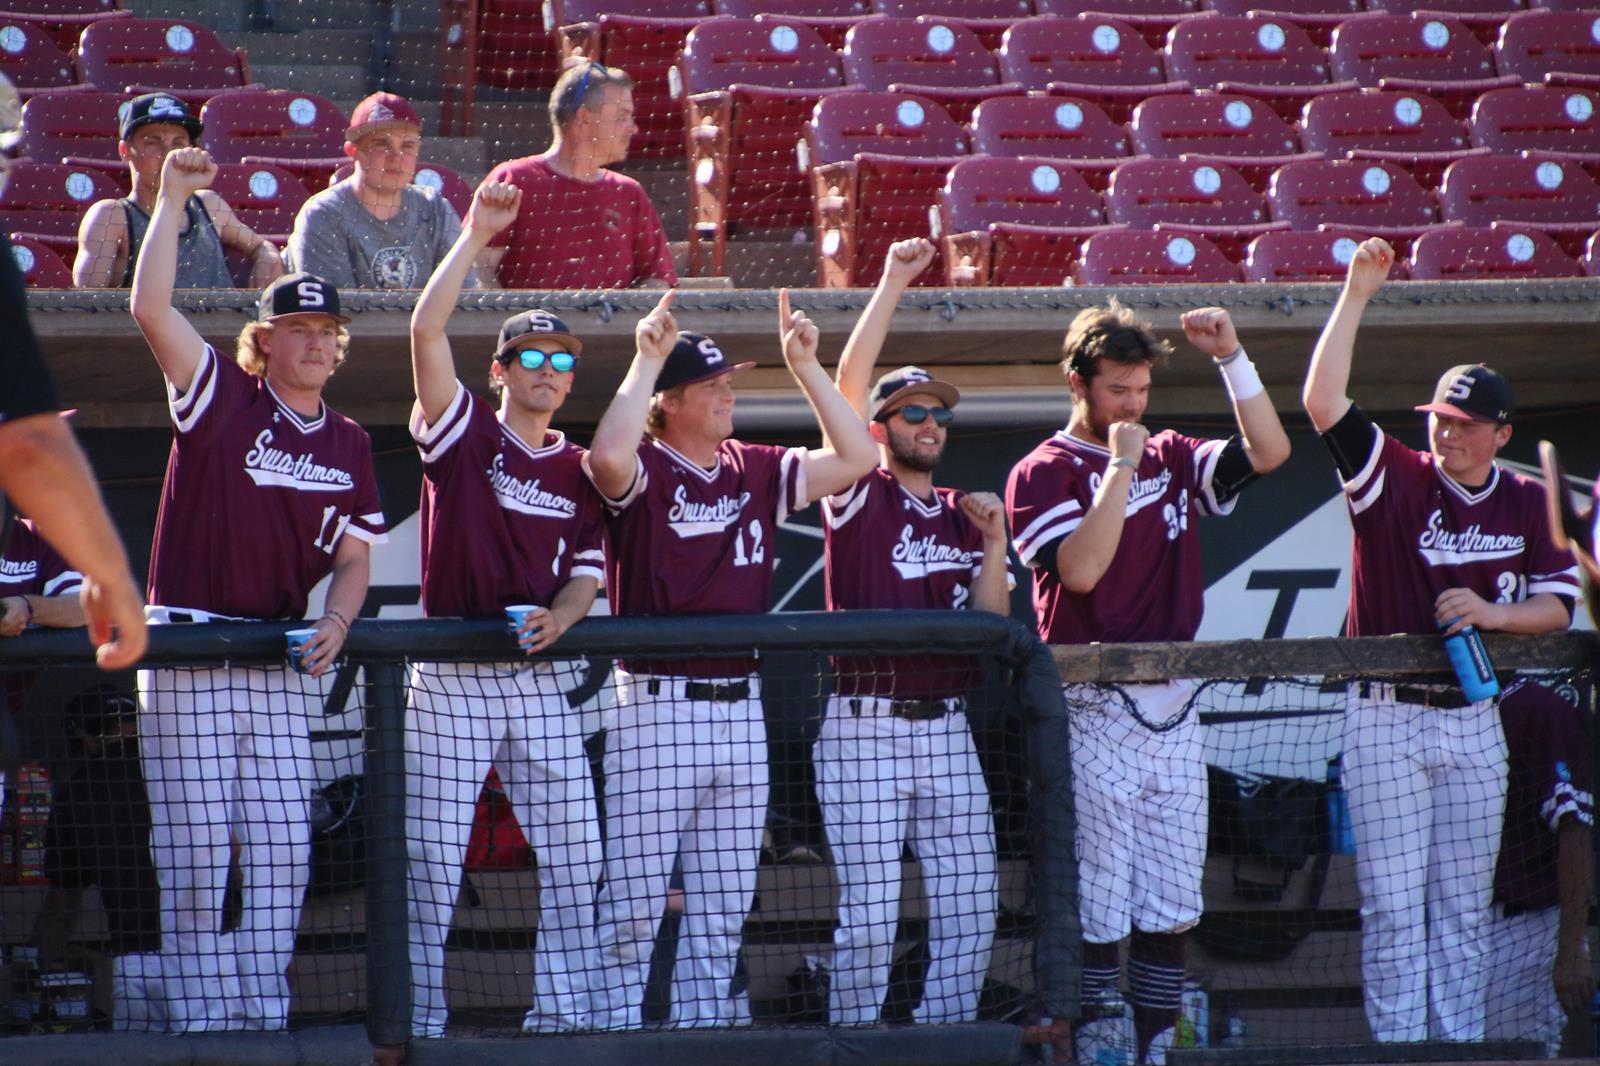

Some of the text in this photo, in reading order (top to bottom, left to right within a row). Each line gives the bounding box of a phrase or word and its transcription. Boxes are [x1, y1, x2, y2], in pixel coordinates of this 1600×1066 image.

[297, 282, 324, 306] S
[529, 312, 554, 331] S
[697, 338, 723, 365] S
[1445, 374, 1476, 399] S
[313, 505, 351, 554] 11
[733, 519, 764, 566] 12
[892, 523, 973, 563] Swthmoe
[1419, 509, 1525, 551] Swrthmore
